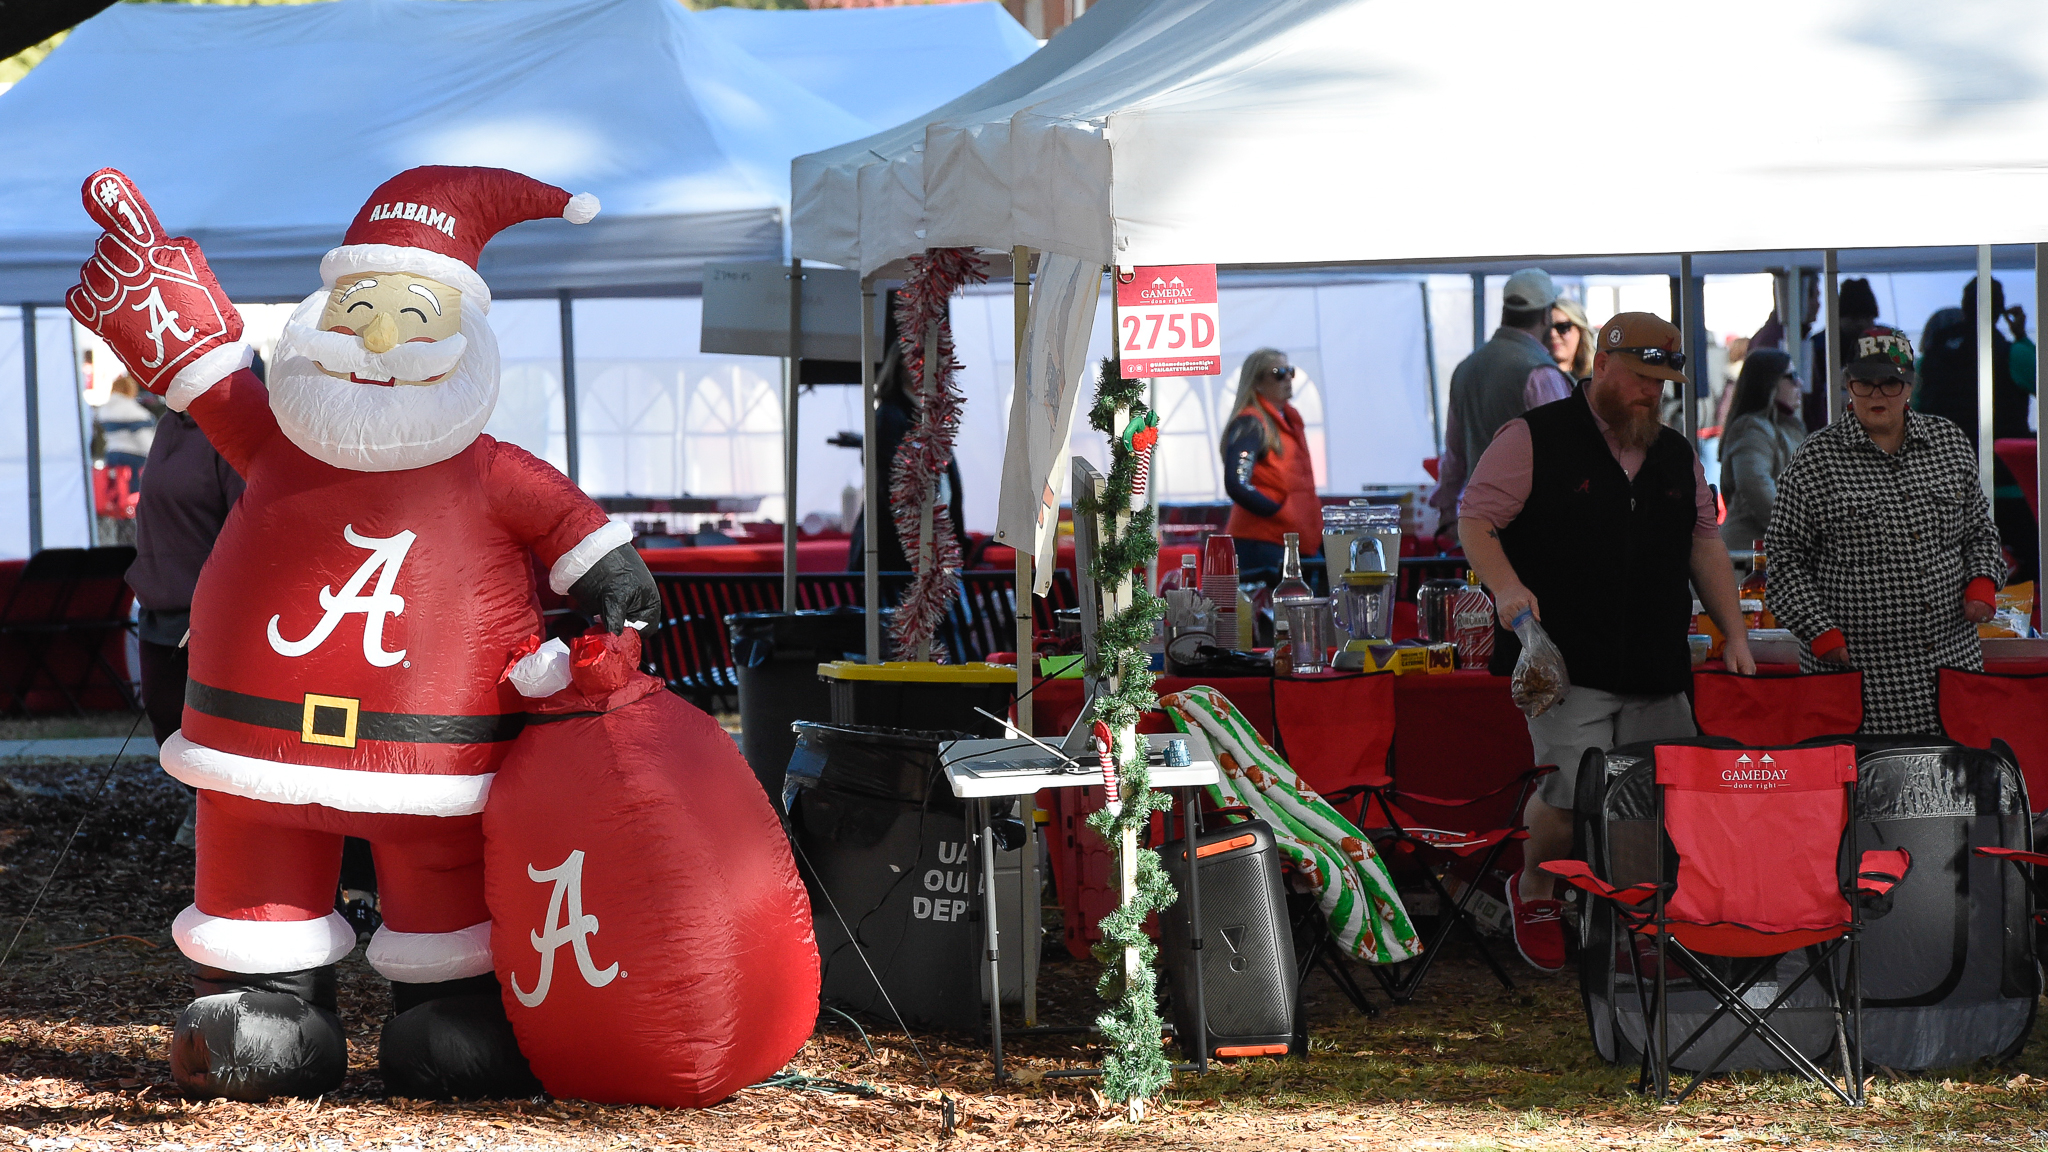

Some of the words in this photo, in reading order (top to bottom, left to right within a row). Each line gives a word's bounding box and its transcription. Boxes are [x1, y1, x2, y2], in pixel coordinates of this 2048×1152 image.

[100, 179, 144, 236] #1
[368, 201, 456, 238] ALABAMA
[1141, 288, 1193, 298] GAMEDAY
[131, 286, 195, 369] A
[1122, 312, 1215, 351] 275D
[1858, 335, 1914, 361] RTR
[267, 523, 417, 668] A
[1721, 769, 1788, 781] GAMEDAY
[1756, 782, 1777, 790] right
[510, 849, 619, 1008] A
